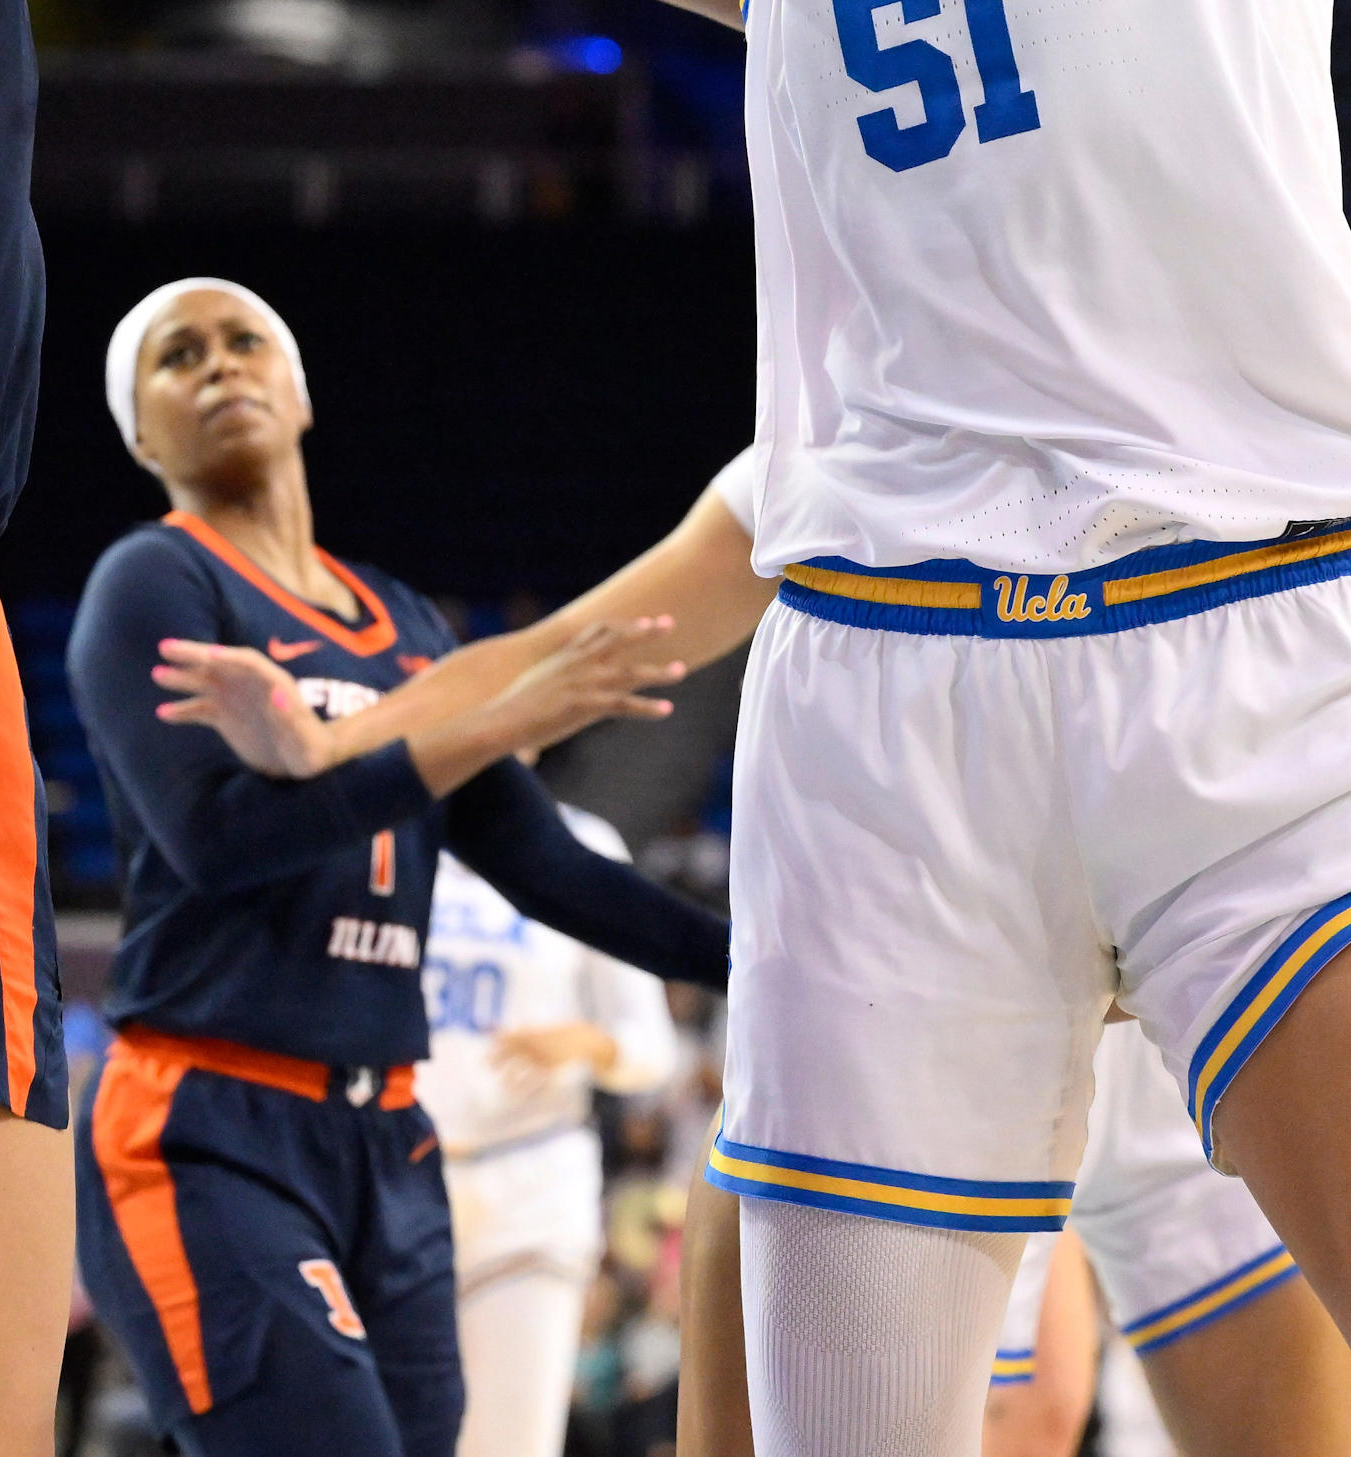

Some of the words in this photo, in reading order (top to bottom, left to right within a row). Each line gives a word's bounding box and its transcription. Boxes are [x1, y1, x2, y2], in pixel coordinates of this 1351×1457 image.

[993, 576, 1092, 622] Ucla
[368, 828, 397, 897] 1
[326, 915, 421, 970] ILLIN
